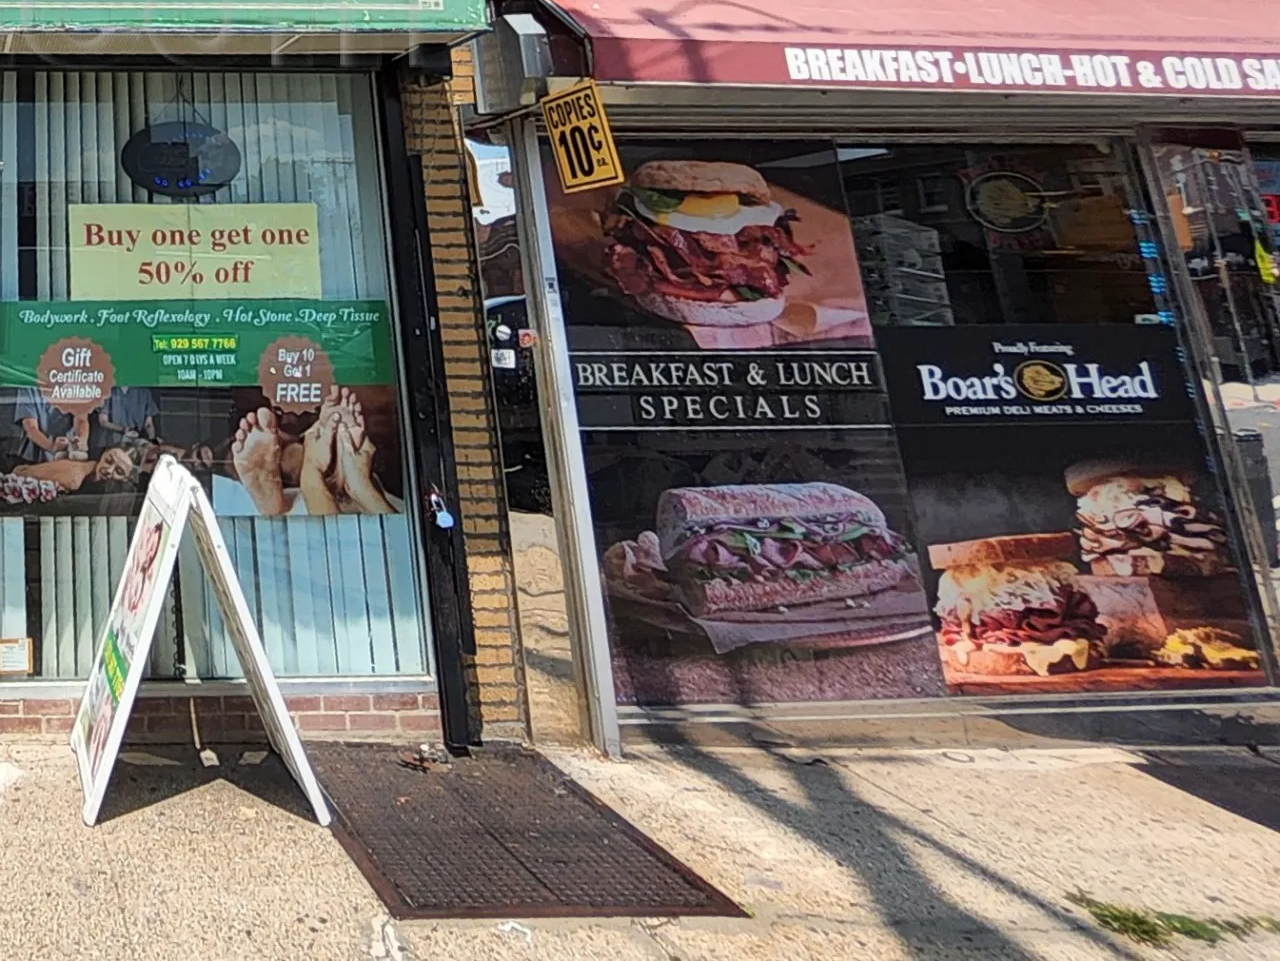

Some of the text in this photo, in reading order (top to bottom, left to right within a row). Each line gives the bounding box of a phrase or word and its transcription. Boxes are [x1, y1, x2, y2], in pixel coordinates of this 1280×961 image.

[1136, 60, 1166, 89] &
[1162, 55, 1244, 90] COLD
[547, 93, 597, 130] COPIES
[83, 223, 311, 252] Buy one get one
[137, 260, 255, 286] 50% off
[19, 306, 380, 328] Bodywork Foot Reflexology Hot Stone Deep Tissue
[170, 339, 189, 350] 929
[191, 338, 210, 350] 567
[61, 346, 92, 368] Gift
[278, 348, 315, 365] Buy 10
[48, 369, 105, 385] Certificate
[575, 361, 873, 387] BREAKFAST & LUNCH
[916, 360, 1160, 402] Boar's Head
[51, 385, 102, 400] Available
[276, 382, 322, 403] FREE
[639, 394, 822, 420] SPECIALS
[945, 405, 1001, 416] PREMIUM
[1004, 405, 1032, 415] DELI
[1086, 404, 1144, 415] CHEESES
